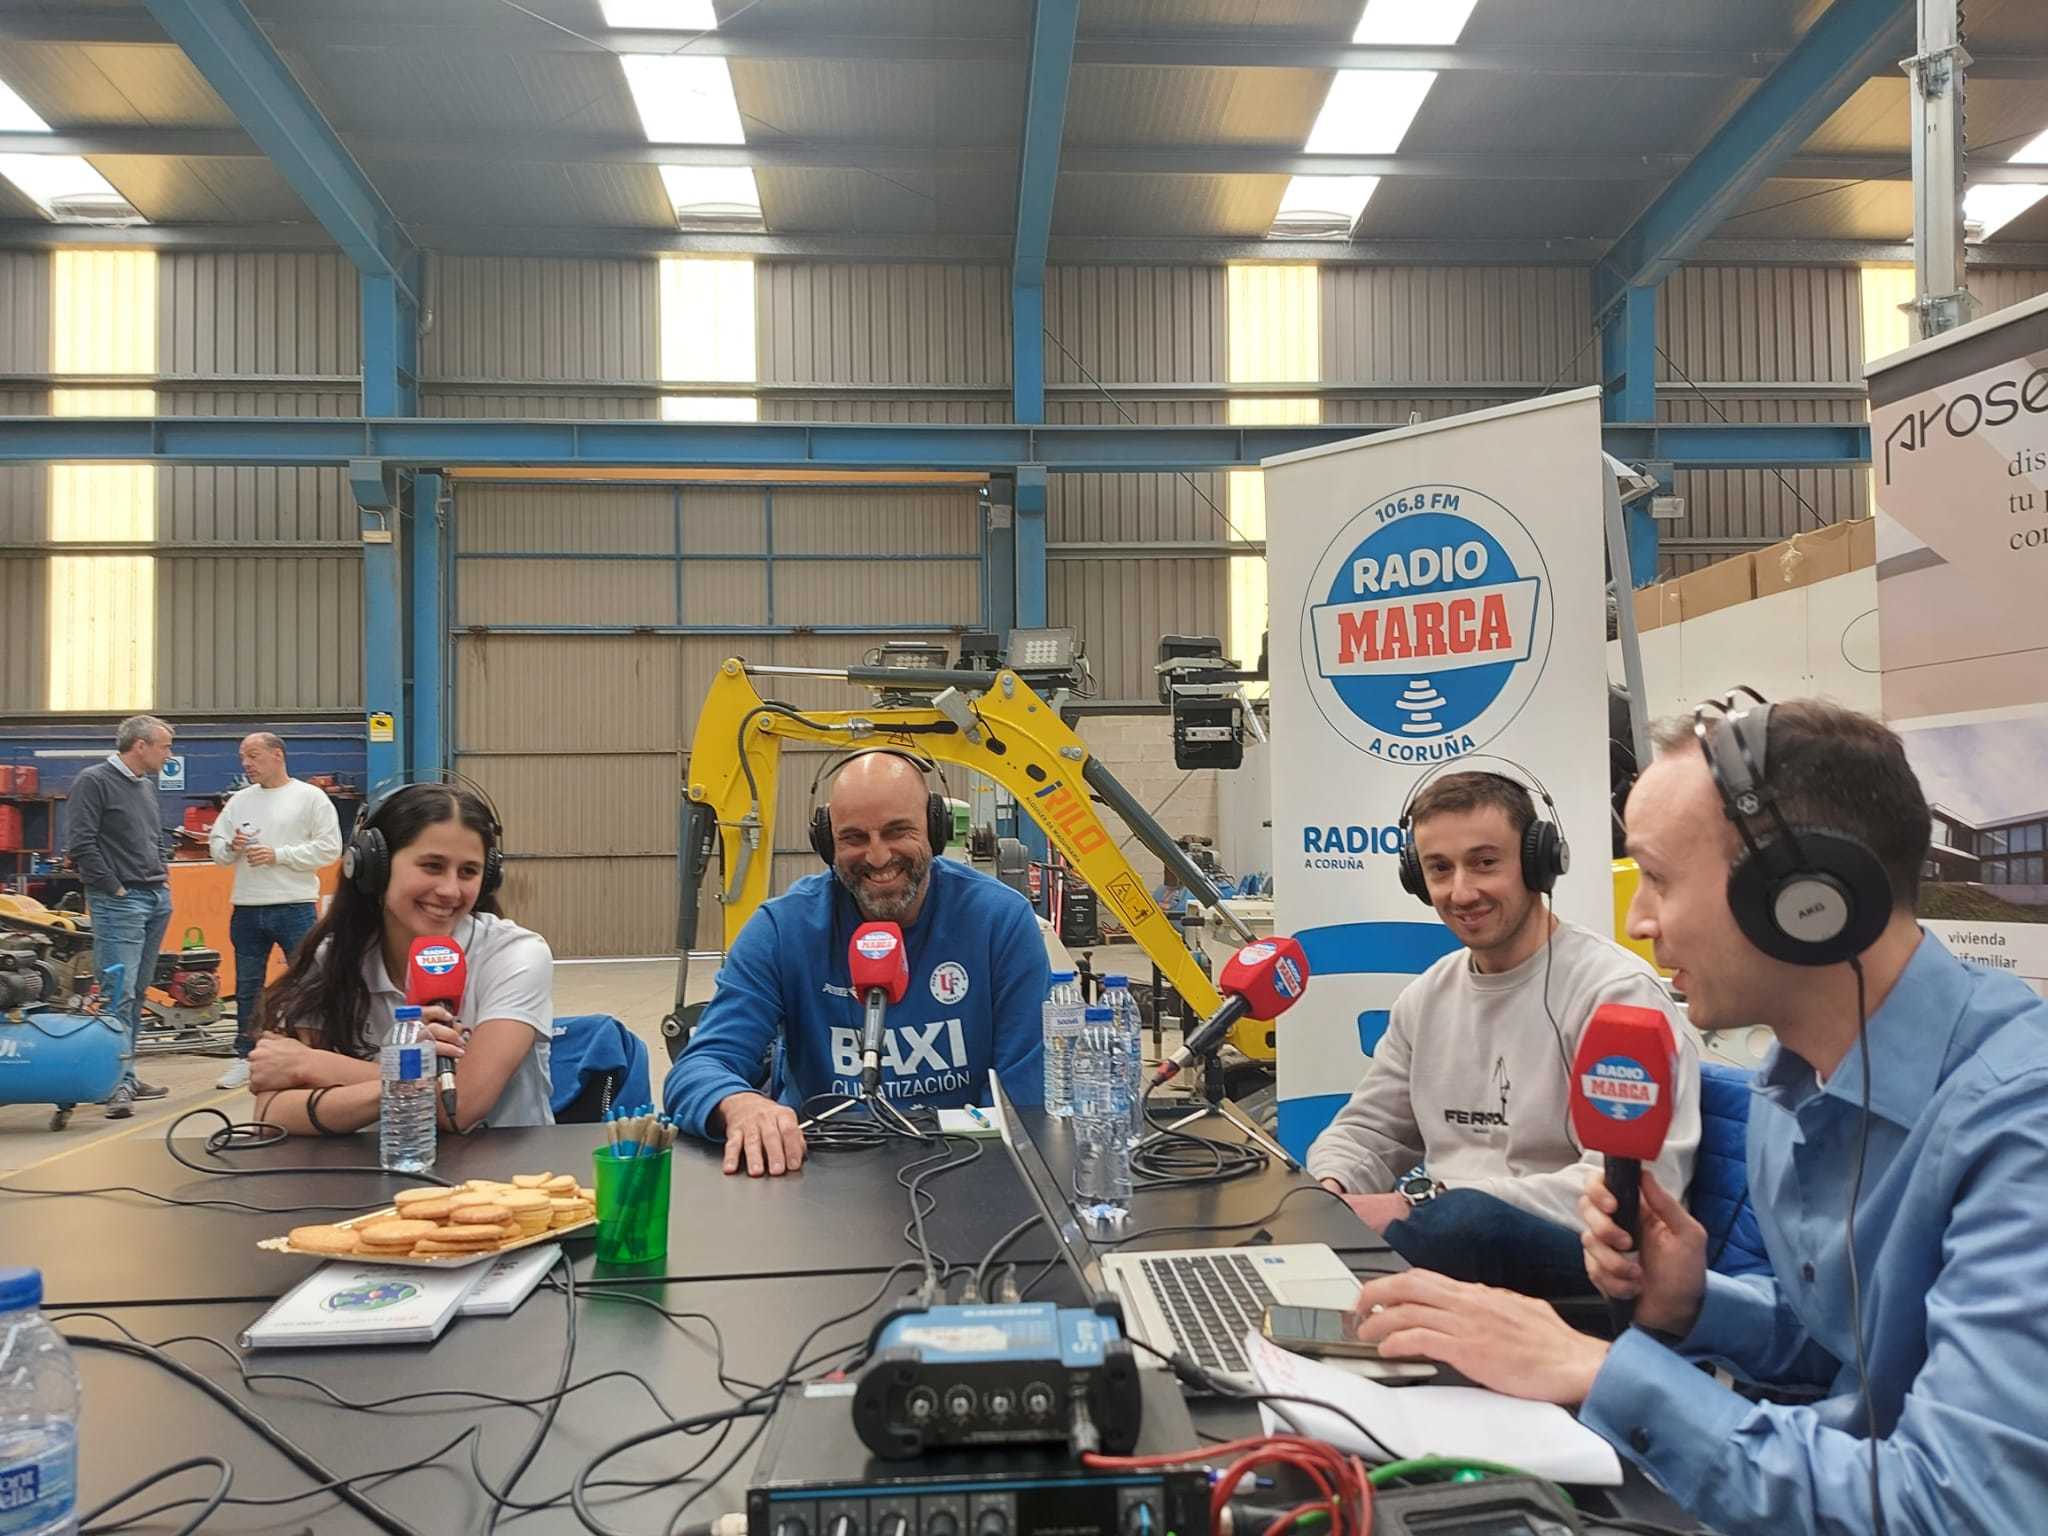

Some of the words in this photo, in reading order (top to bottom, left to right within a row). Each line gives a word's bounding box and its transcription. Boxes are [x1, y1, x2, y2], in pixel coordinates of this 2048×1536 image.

[2007, 448, 2047, 477] dis
[1375, 493, 1425, 523] 106.8
[1431, 493, 1460, 511] FM
[2008, 493, 2034, 514] tu
[1353, 540, 1489, 595] RADIO
[1337, 593, 1513, 665] MARCA
[1369, 737, 1382, 754] A
[1388, 733, 1476, 762] CORUÑA
[1304, 826, 1403, 855] RADIO
[1305, 859, 1312, 868] A
[1315, 857, 1364, 870] CORUÑA
[1947, 931, 2007, 947] vivienda
[831, 1070, 970, 1099] CLIATIZACIÓN
[1596, 1063, 1645, 1081] RADIO
[1591, 1080, 1650, 1101] MARCA
